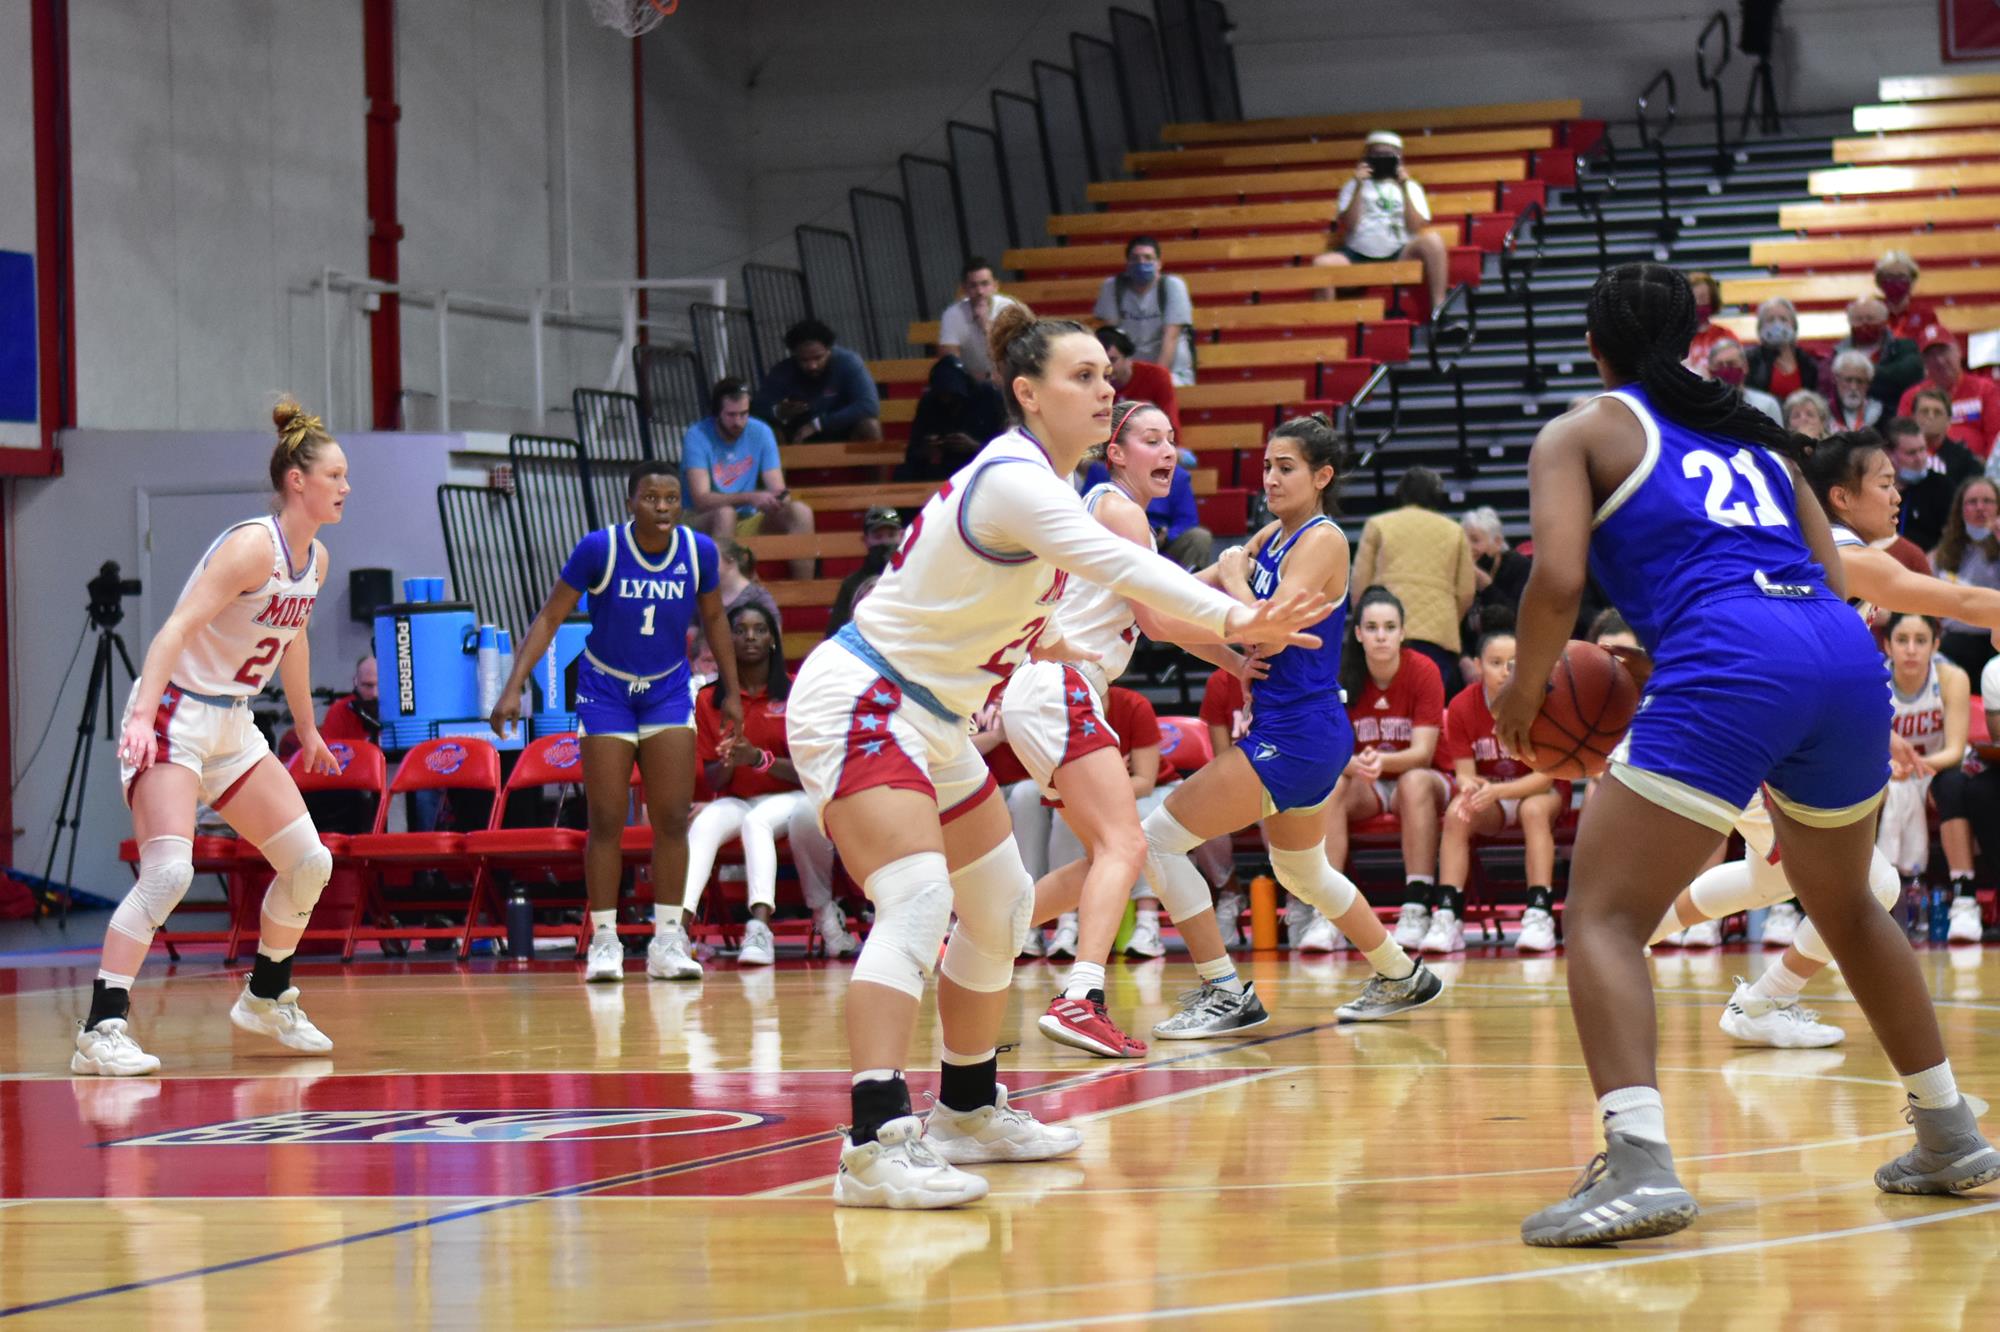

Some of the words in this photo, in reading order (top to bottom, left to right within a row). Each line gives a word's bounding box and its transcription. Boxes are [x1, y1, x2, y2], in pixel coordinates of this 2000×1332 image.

[1682, 448, 1789, 527] 21
[619, 578, 685, 600] LYNN
[639, 604, 656, 636] 1
[976, 616, 1049, 678] 2
[233, 636, 292, 688] 2
[396, 621, 414, 712] POWERADE
